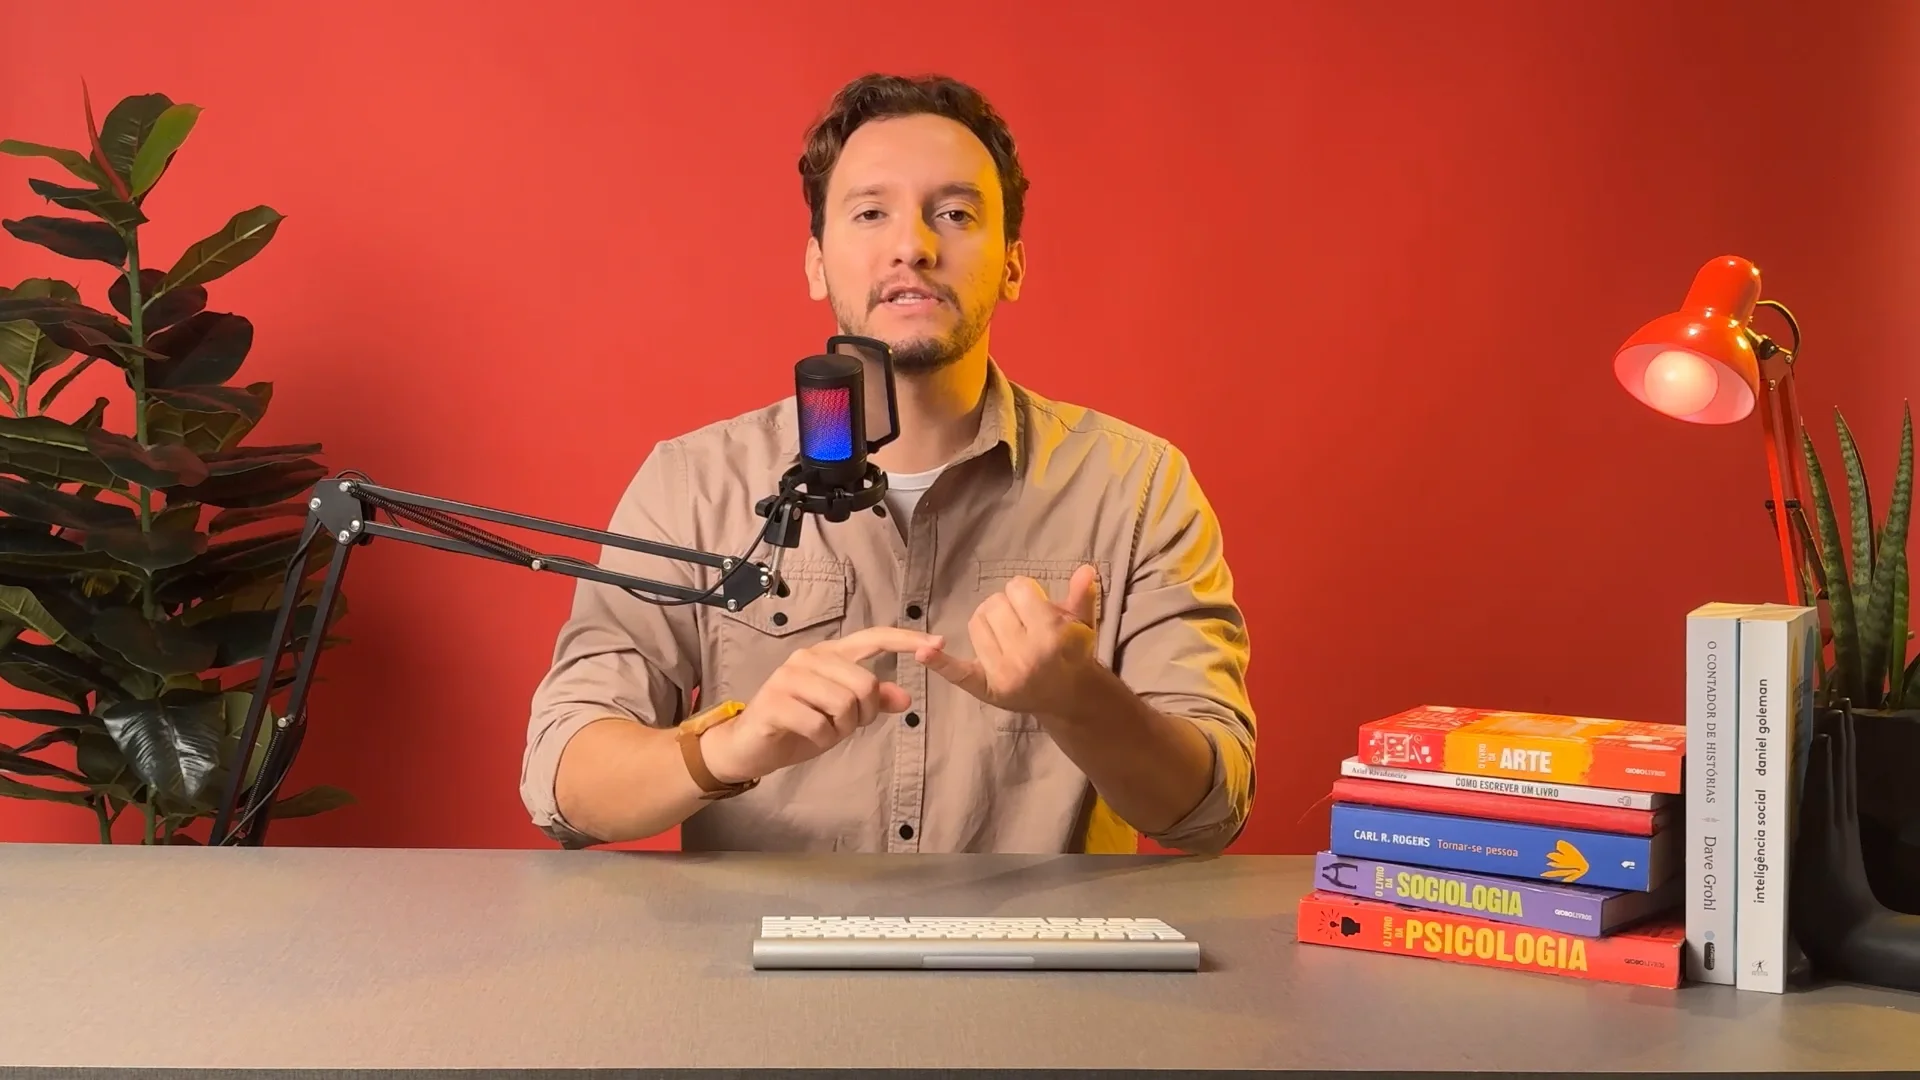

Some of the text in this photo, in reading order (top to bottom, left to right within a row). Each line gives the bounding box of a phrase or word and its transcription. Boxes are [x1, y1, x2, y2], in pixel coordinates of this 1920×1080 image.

[1705, 640, 1718, 804] O CONTADOR DE HISTÓRIAS
[1755, 678, 1771, 777] daniel goleman
[1499, 747, 1553, 774] ARTE
[1455, 776, 1559, 798] COMO ESCREVER UM LIVRO
[1353, 829, 1431, 848] CARL R. ROGERS
[1437, 838, 1519, 857] Tornar-se pessoa
[1753, 789, 1769, 904] inteligência social
[1375, 866, 1385, 890] LIVRO
[1385, 878, 1394, 889] DA
[1703, 836, 1717, 911] Dave Grohl
[1396, 871, 1524, 918] SOCIOLOGIA
[1382, 916, 1393, 940] LIVRO
[1405, 918, 1588, 972] PSICOLOGIA
